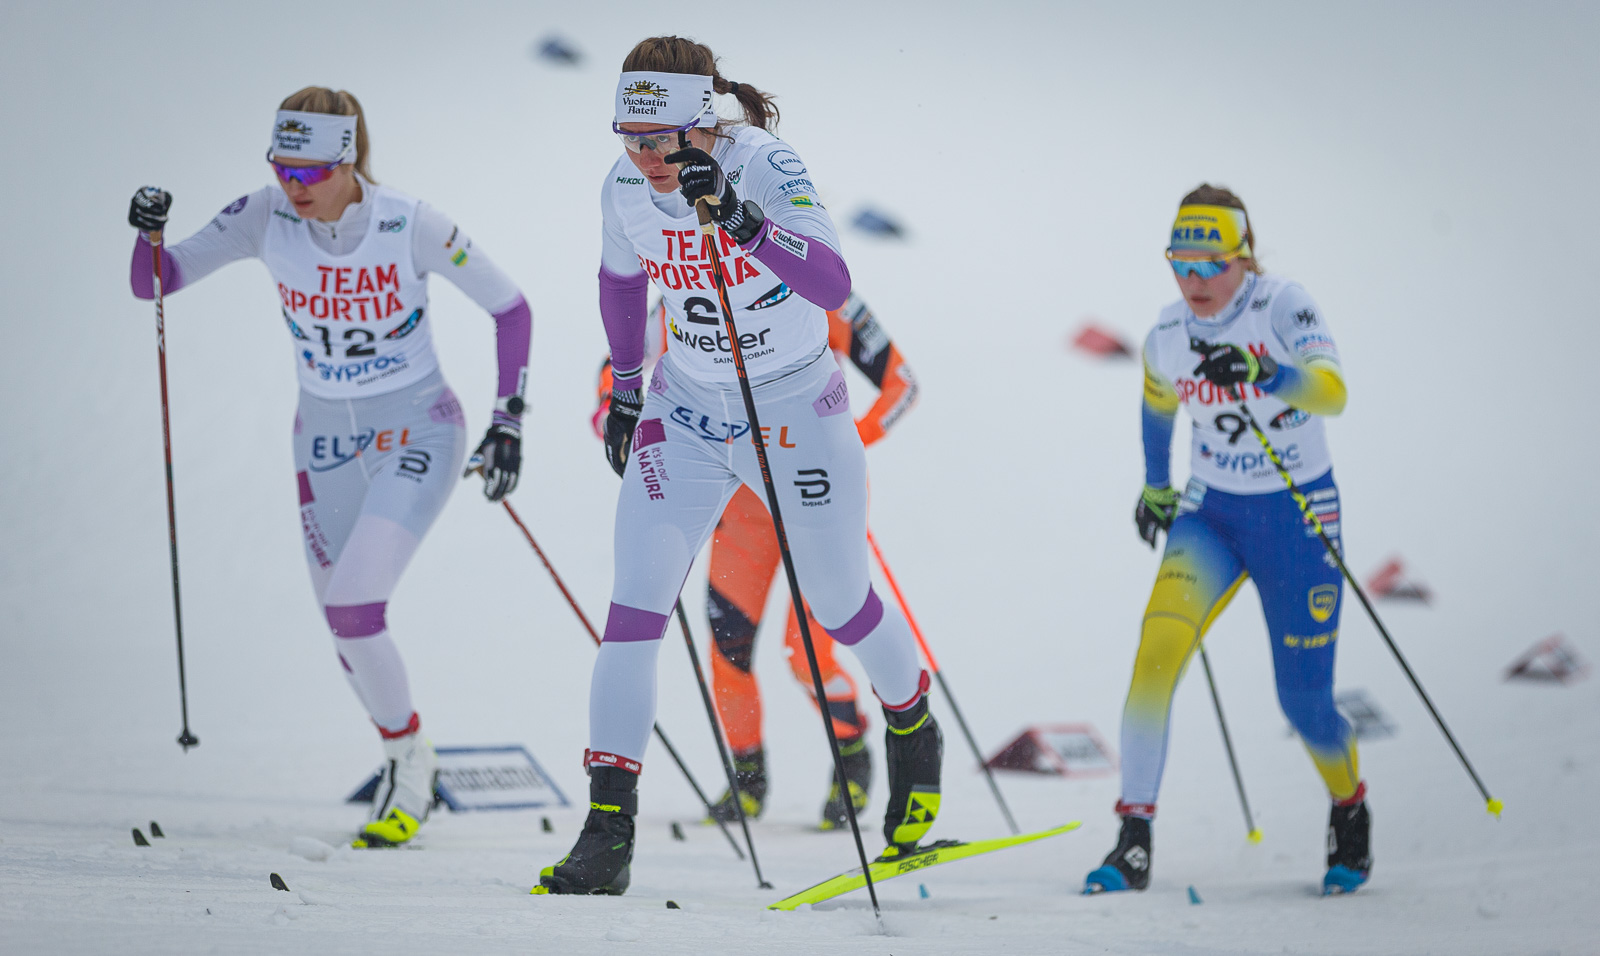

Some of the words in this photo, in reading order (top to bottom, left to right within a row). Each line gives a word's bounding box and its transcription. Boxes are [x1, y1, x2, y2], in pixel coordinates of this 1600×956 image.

[623, 97, 667, 107] Vuokatin
[627, 105, 657, 115] Aateli
[1173, 227, 1223, 243] KISA
[317, 263, 401, 294] TEAM
[278, 281, 404, 321] SPORTIA
[313, 324, 377, 358] 12
[671, 324, 771, 353] weber
[1213, 413, 1250, 446] 9
[637, 450, 666, 501] NATURE
[654, 458, 664, 468] in
[657, 466, 670, 482] our
